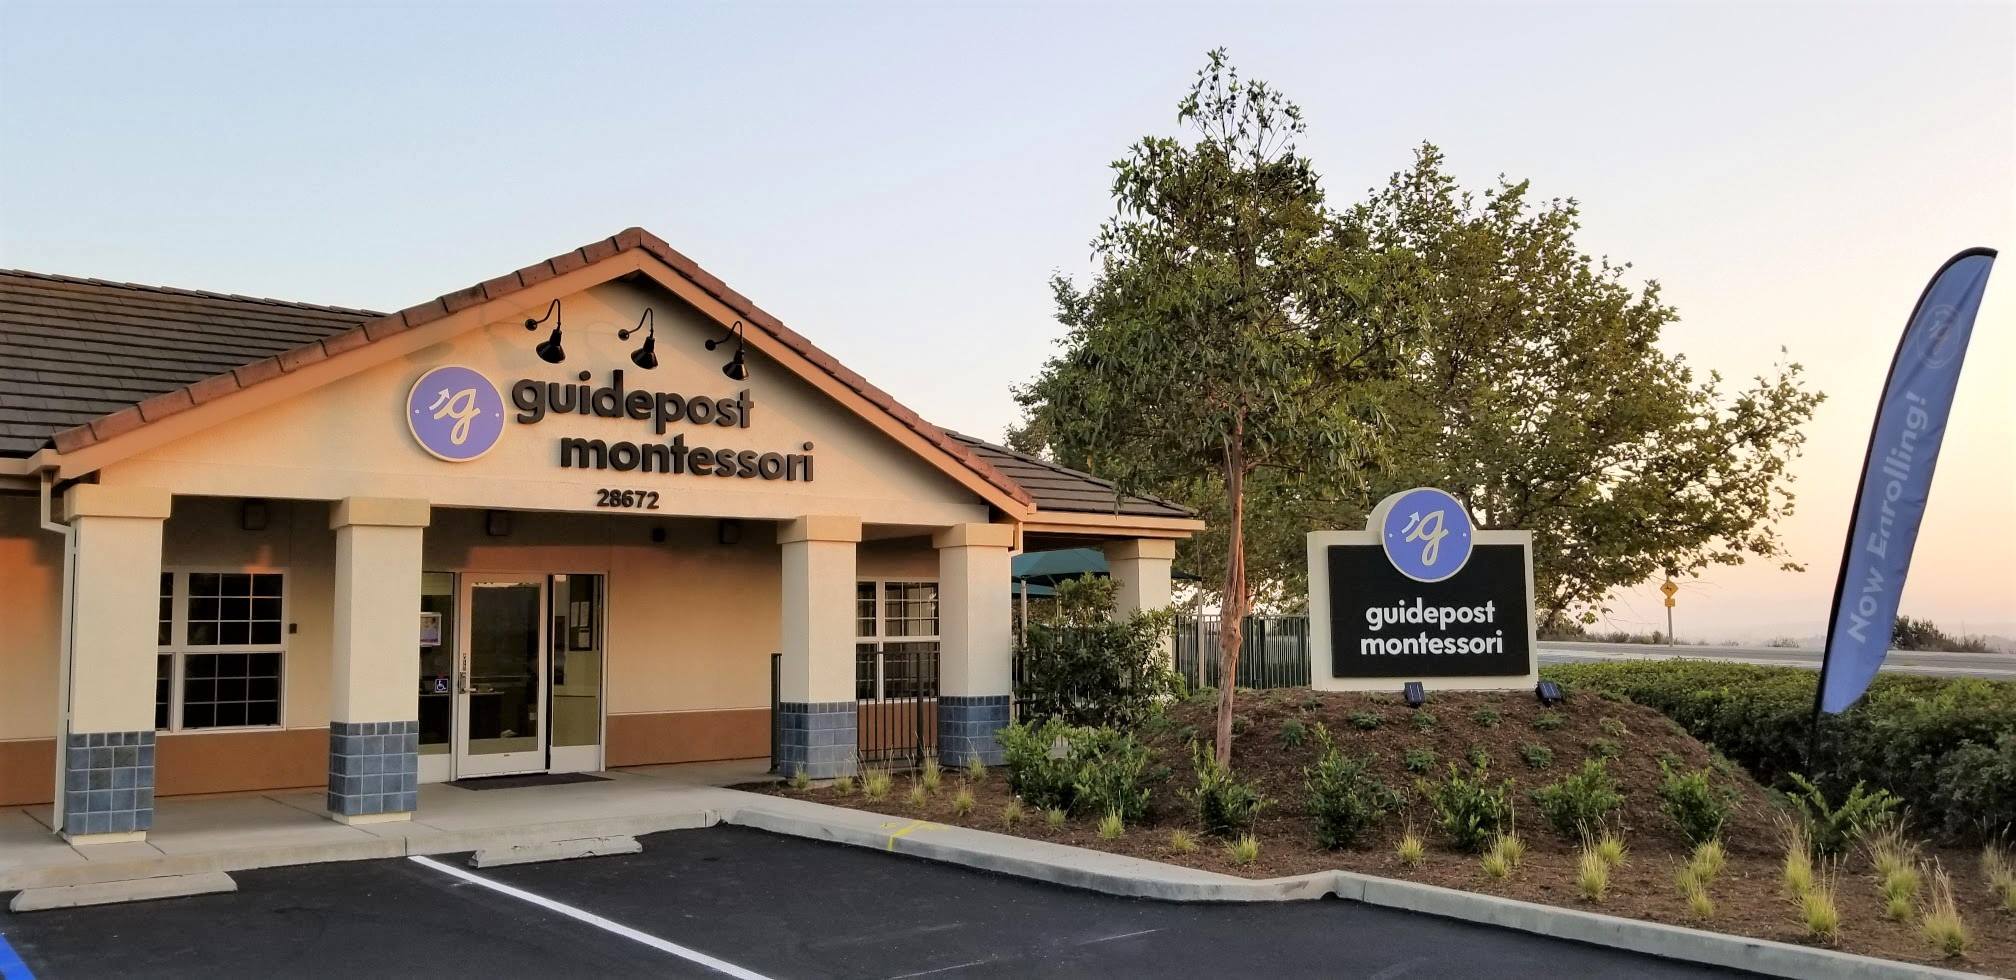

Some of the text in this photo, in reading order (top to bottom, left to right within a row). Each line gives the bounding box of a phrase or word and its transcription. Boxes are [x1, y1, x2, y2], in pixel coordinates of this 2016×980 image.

[511, 369, 755, 435] guidepost
[560, 433, 814, 482] montessori
[596, 488, 660, 509] 28672
[1847, 390, 1928, 644] Now Enrolling!
[1365, 597, 1496, 631] guidepost
[1360, 630, 1503, 655] montessori
